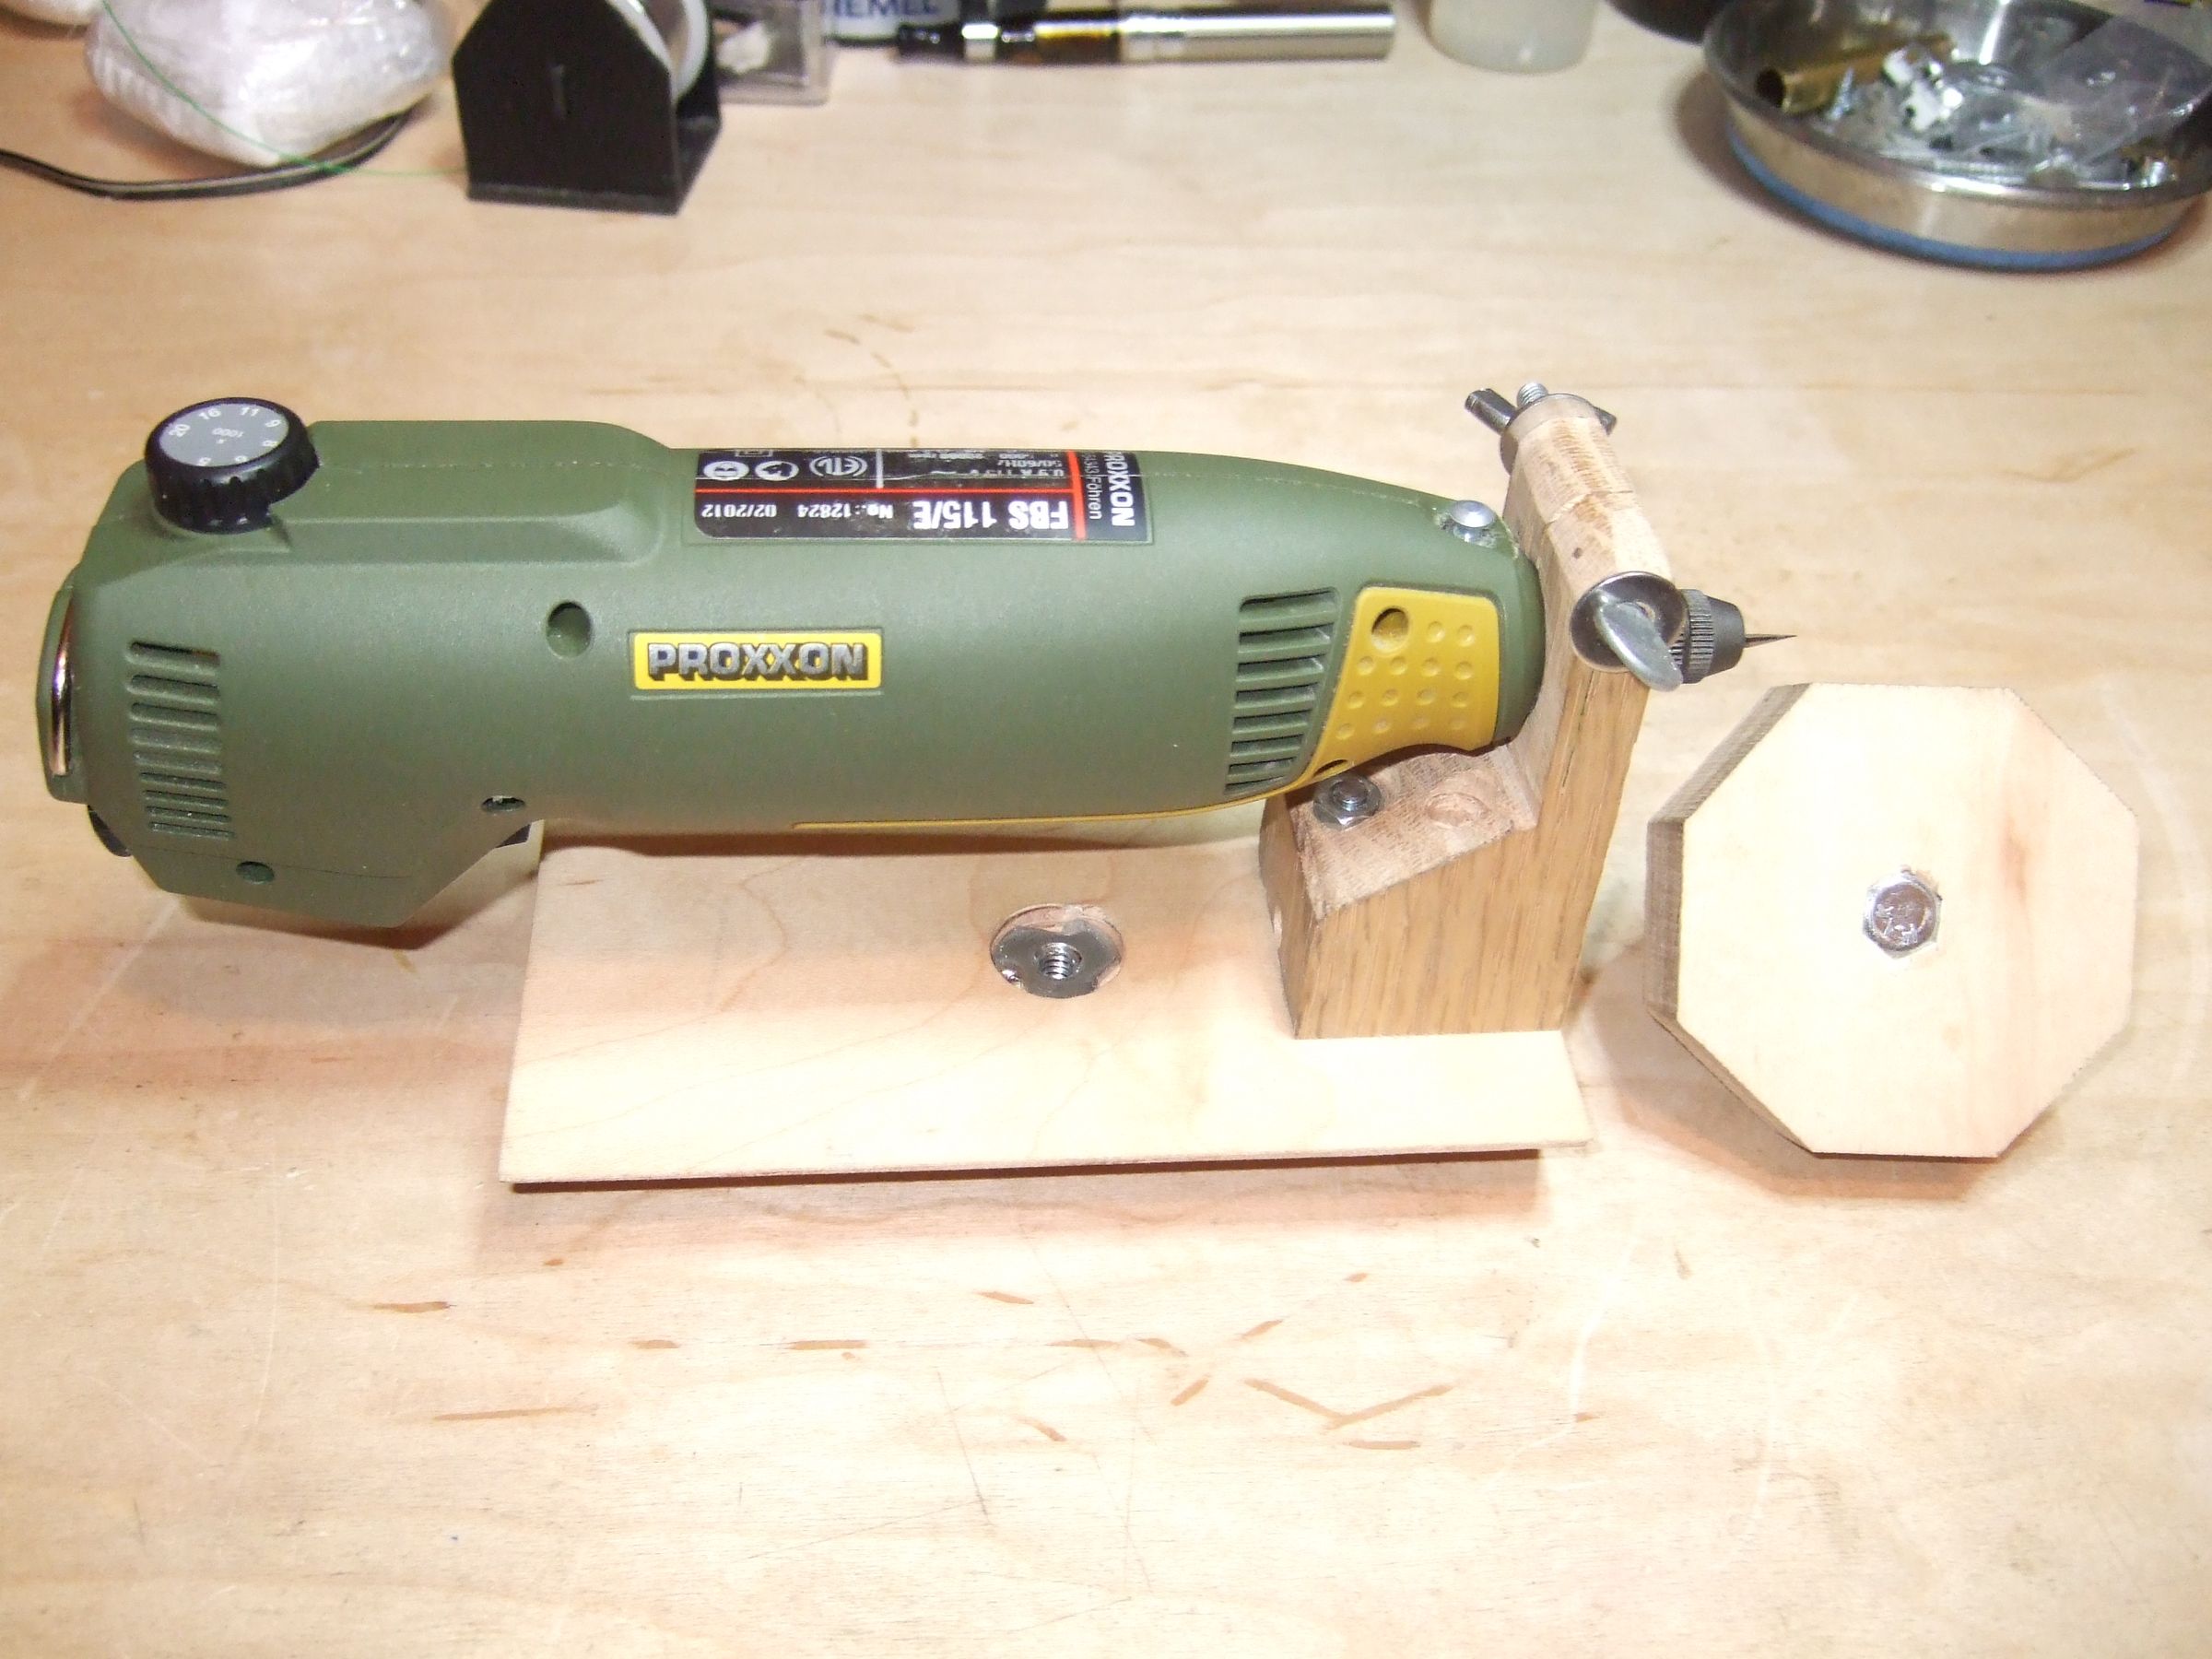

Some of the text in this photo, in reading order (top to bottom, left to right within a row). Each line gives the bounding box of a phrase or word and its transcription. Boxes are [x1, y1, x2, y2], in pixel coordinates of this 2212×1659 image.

[198, 407, 222, 420] 16
[169, 423, 191, 438] 20
[1086, 476, 1103, 520] Föhren
[700, 503, 777, 518] 02/2012
[796, 502, 852, 519] 12824
[912, 500, 997, 530] 115/E
[1007, 500, 1069, 530] FBS
[647, 641, 869, 681] PROXXON
